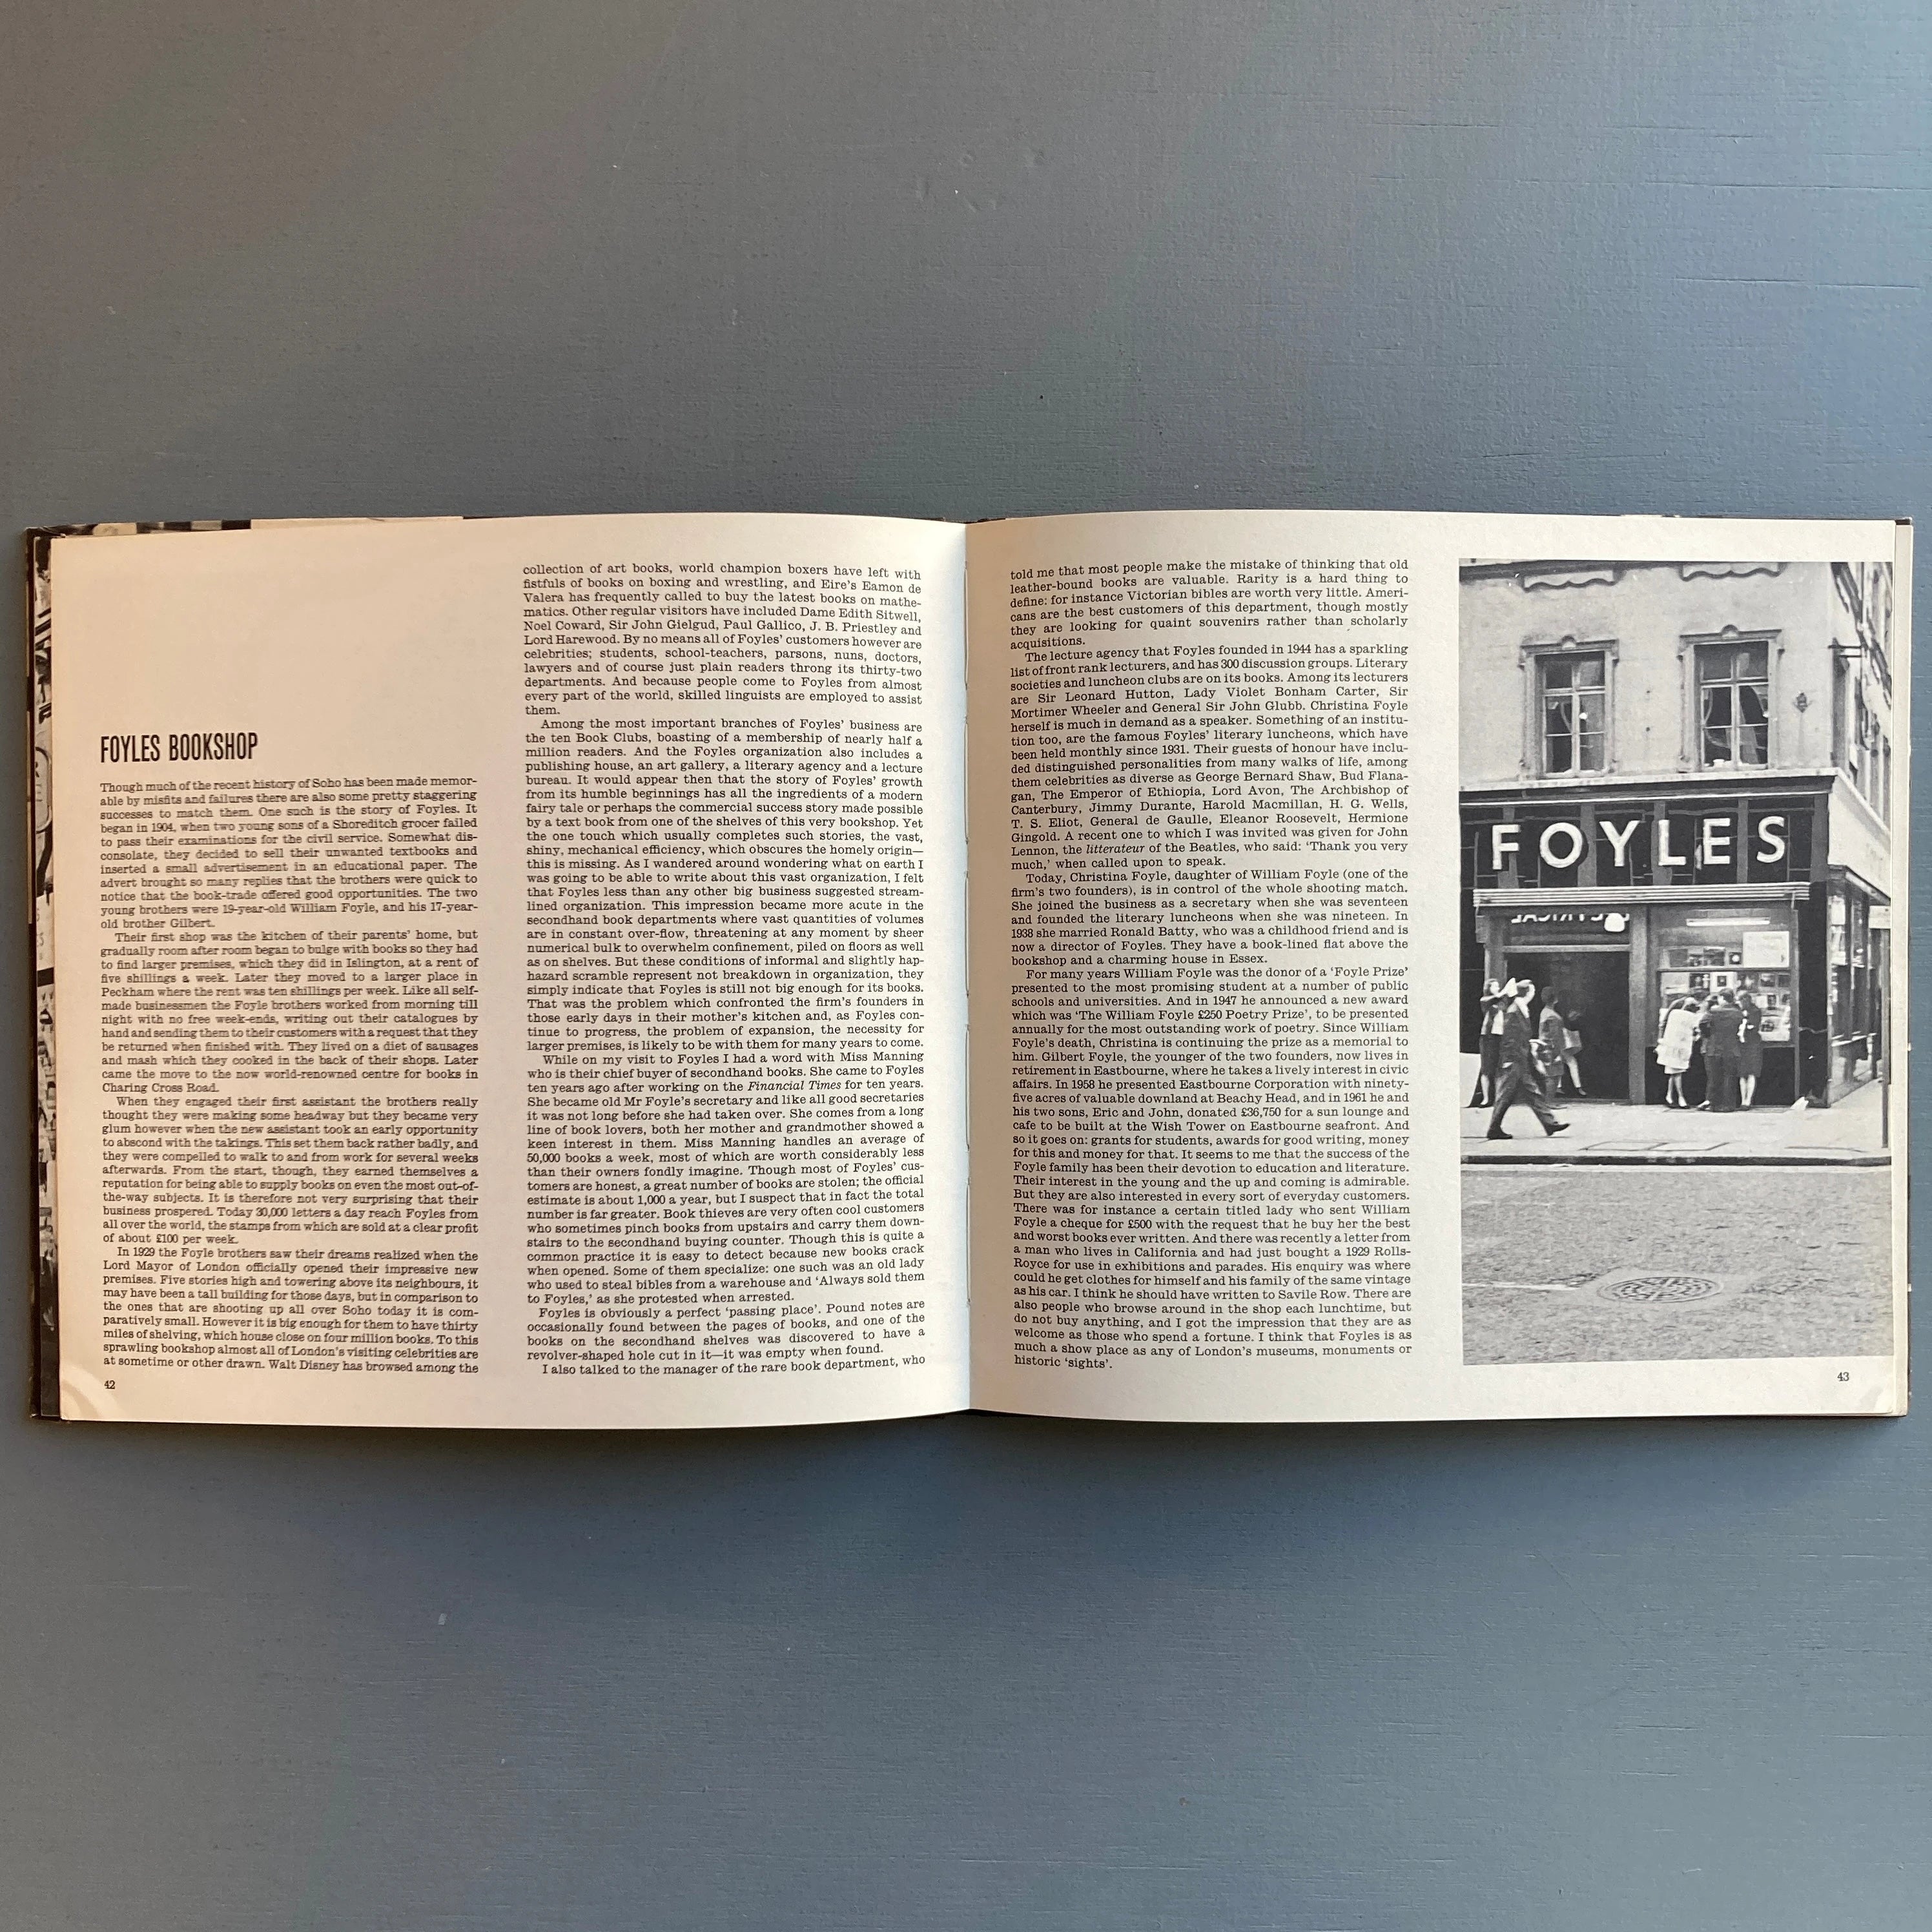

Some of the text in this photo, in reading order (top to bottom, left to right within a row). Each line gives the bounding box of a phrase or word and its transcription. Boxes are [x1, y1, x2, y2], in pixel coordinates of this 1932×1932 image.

[522, 563, 921, 580] collection of art books, world champion boxers have left with
[1010, 579, 1093, 594] leather-bound
[1100, 577, 1136, 588] books
[1172, 575, 1229, 585] valuable.
[1237, 574, 1279, 585] Rarity
[1286, 573, 1297, 583] is
[1319, 573, 1348, 583] hard
[1355, 573, 1388, 584] thing
[1395, 574, 1408, 583] to
[524, 648, 921, 664] celebrities; students, school-teachers, parsons, nuns, doctors,
[1038, 693, 1056, 703] Sir
[1065, 690, 1116, 702] Leonard
[1125, 689, 1174, 699] Hutton,
[1184, 687, 1217, 699] Lady
[1226, 687, 1266, 697] Violet
[1275, 686, 1326, 696] Bonham
[1336, 686, 1379, 697] Carter,
[1390, 686, 1408, 696] Sir
[101, 732, 258, 763] FOYLES BOOKSHOP
[1011, 813, 1408, 828] T. S. Eliot, General de Gaulle, Eleanor Roosevelt, Hermione
[101, 838, 113, 847] to
[117, 839, 141, 848] pass
[145, 836, 174, 846] their
[178, 836, 257, 845] examinations
[261, 835, 279, 844] for
[282, 834, 302, 843] the
[306, 834, 334, 843] civil
[336, 833, 383, 843] service.
[387, 832, 451, 842] Somewhat
[526, 831, 547, 841] the
[580, 831, 616, 840] touch
[621, 830, 659, 840] which
[664, 830, 711, 841] usually
[716, 830, 779, 841] completes
[786, 830, 814, 840] such
[819, 831, 864, 842] stories,
[871, 832, 889, 841] the
[896, 832, 923, 843] vast,
[1492, 816, 1785, 870] FOYLES
[100, 846, 478, 861] consolate, they decided to sell their unwanted textbooks and
[114, 932, 147, 942] Their
[151, 932, 176, 941] first
[179, 932, 207, 943] shop
[236, 931, 257, 941] the
[261, 931, 307, 941] kitchen
[311, 930, 324, 940] of
[327, 930, 358, 940] their
[415, 930, 452, 940] home,
[457, 930, 478, 939] but
[1013, 1120, 1036, 1130] cafe
[1041, 1121, 1052, 1130] to
[1058, 1121, 1070, 1130] be
[1075, 1121, 1105, 1131] built
[1127, 1122, 1147, 1131] the
[1152, 1122, 1182, 1131] Wish
[1187, 1122, 1226, 1131] Tower
[1250, 1122, 1321, 1131] Eastbourne
[1326, 1121, 1380, 1130] seafront.
[1384, 1120, 1410, 1130] And
[528, 1139, 557, 1149] keen
[563, 1139, 613, 1149] interest
[620, 1138, 633, 1149] in
[641, 1138, 676, 1149] them.
[684, 1138, 713, 1147] Miss
[721, 1137, 776, 1148] Manning
[783, 1136, 830, 1146] handles
[861, 1136, 906, 1145] average
[914, 1133, 925, 1142] of
[103, 1192, 478, 1206] the-way subjects. It is therefore not very surprising that their
[1013, 1203, 1047, 1215] There
[1050, 1204, 1075, 1215] was
[1080, 1205, 1098, 1214] for
[1103, 1205, 1156, 1215] instance
[1175, 1206, 1220, 1215] certain
[1226, 1206, 1260, 1215] titled
[1266, 1206, 1293, 1217] lady
[1299, 1205, 1324, 1215] who
[1330, 1205, 1356, 1215] sent
[1361, 1204, 1410, 1214] William
[103, 1260, 130, 1269] Lord
[136, 1260, 174, 1271] Mayor
[179, 1262, 192, 1271] of
[196, 1262, 240, 1271] London
[245, 1262, 298, 1274] officially
[303, 1263, 344, 1275] opened
[349, 1264, 379, 1273] their
[385, 1264, 448, 1276] impressive
[527, 1336, 563, 1346] books
[594, 1336, 614, 1346] the
[622, 1336, 695, 1346] secondhand
[703, 1335, 749, 1346] shelves
[789, 1331, 854, 1343] discovered
[863, 1330, 875, 1340] to
[883, 1329, 910, 1339] have
[104, 1380, 115, 1389] 42
[1837, 1372, 1849, 1381] 43
